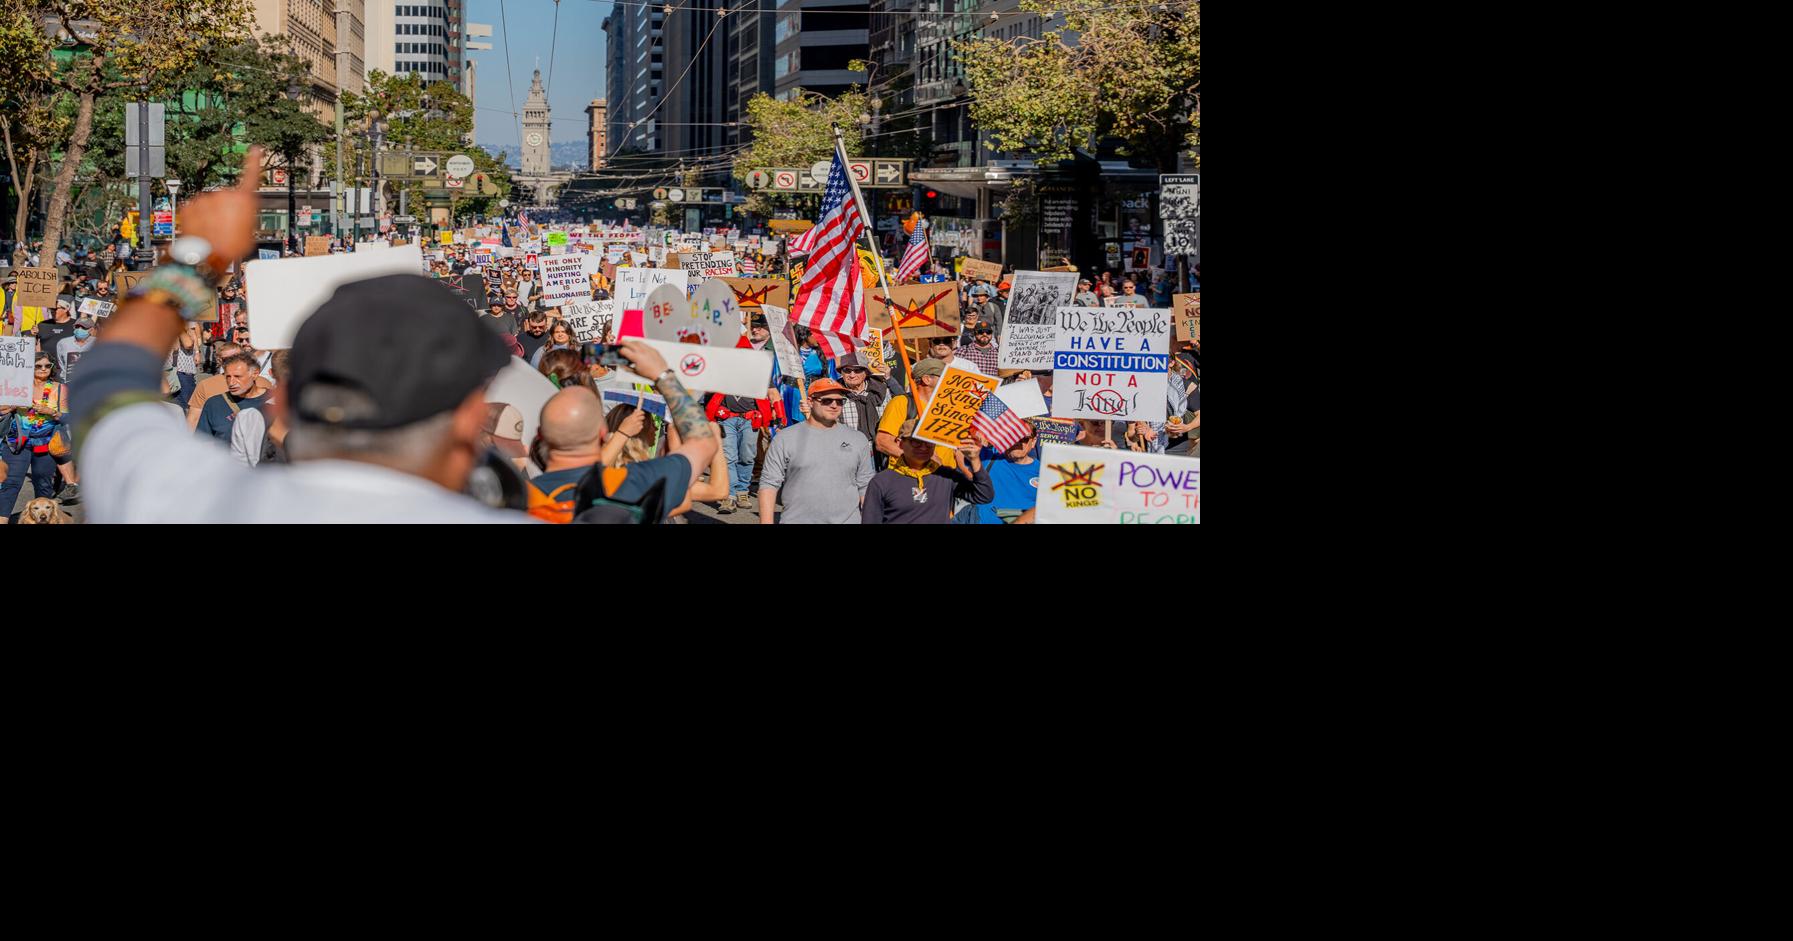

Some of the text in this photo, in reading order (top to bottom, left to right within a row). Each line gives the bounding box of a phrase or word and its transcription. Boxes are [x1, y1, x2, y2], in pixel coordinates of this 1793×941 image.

[476, 254, 490, 263] NOT
[692, 253, 714, 261] STOP
[546, 264, 582, 273] MINORITY
[681, 260, 732, 270] PRETENDING
[19, 270, 57, 281] ABOLISH
[547, 271, 581, 279] HURTING
[687, 267, 733, 277] OUR RACISM
[22, 281, 52, 294] ICE
[546, 277, 588, 287] AMERICA
[544, 290, 591, 300] BILLIONAIRES
[652, 302, 672, 319] BE
[570, 313, 614, 328] ARE SIC
[1059, 310, 1088, 333] We
[576, 330, 594, 342] HIS
[1070, 336, 1151, 352] HAVE A
[1057, 354, 1167, 370] CONSTITUTION
[946, 375, 976, 389] No
[1075, 372, 1138, 387] NOT A
[931, 402, 975, 424] Since
[924, 418, 974, 440] 1776
[1118, 460, 1200, 490] POWE
[1064, 487, 1097, 501] NO
[1140, 491, 1169, 507] TO
[1066, 499, 1099, 508] KINGS
